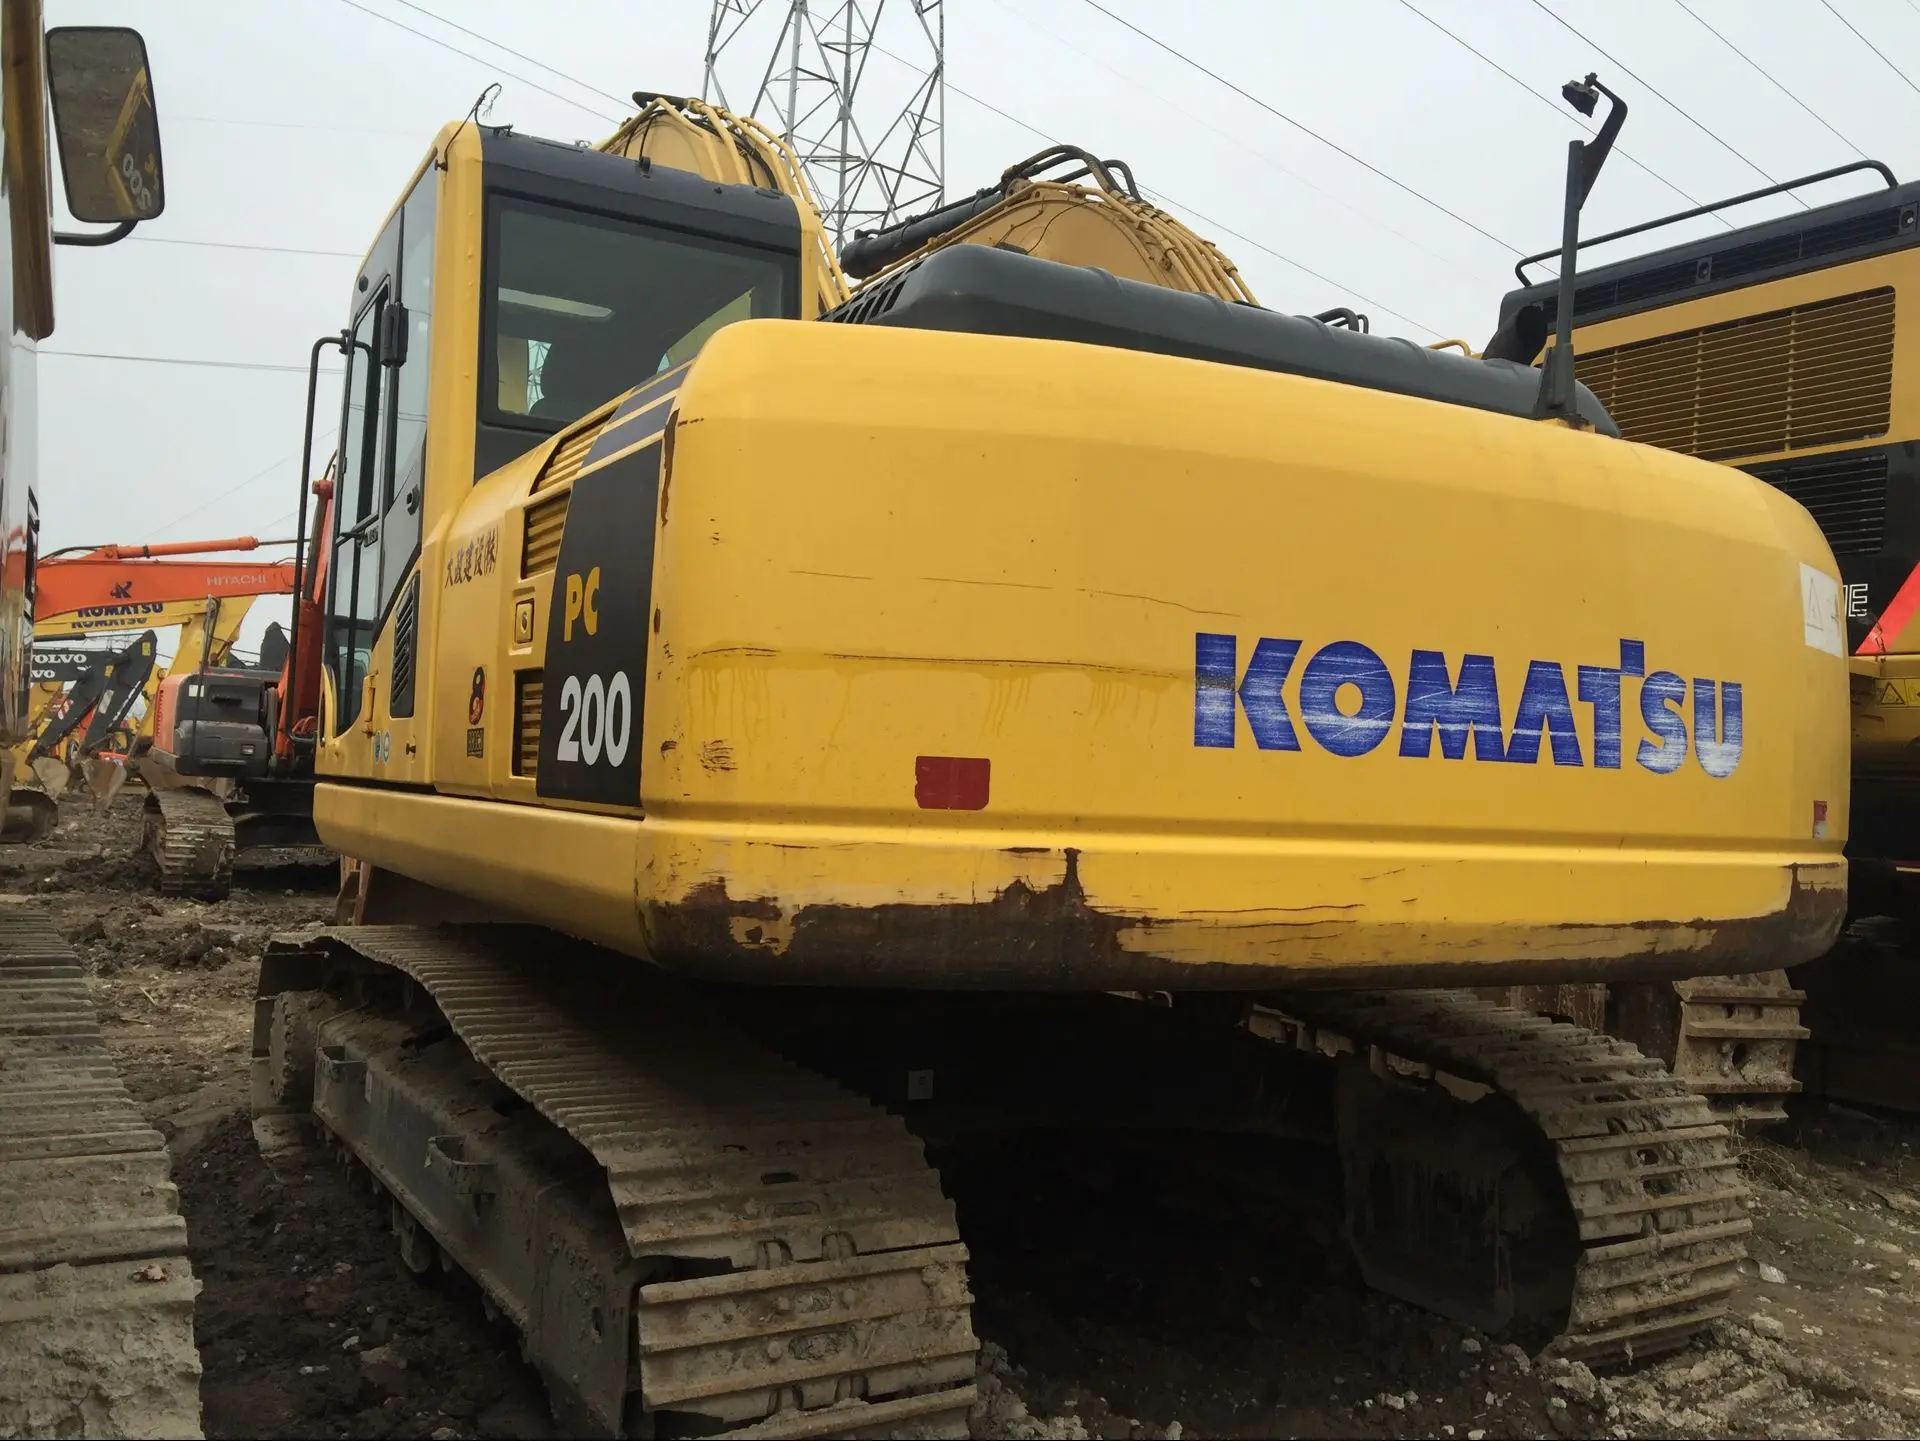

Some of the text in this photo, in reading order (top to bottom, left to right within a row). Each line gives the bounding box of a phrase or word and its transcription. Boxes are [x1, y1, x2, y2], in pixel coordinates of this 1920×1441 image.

[206, 574, 266, 586] HITACHI
[563, 566, 600, 642] PC
[557, 670, 632, 768] 200
[1194, 632, 1743, 778] KOMATSU
